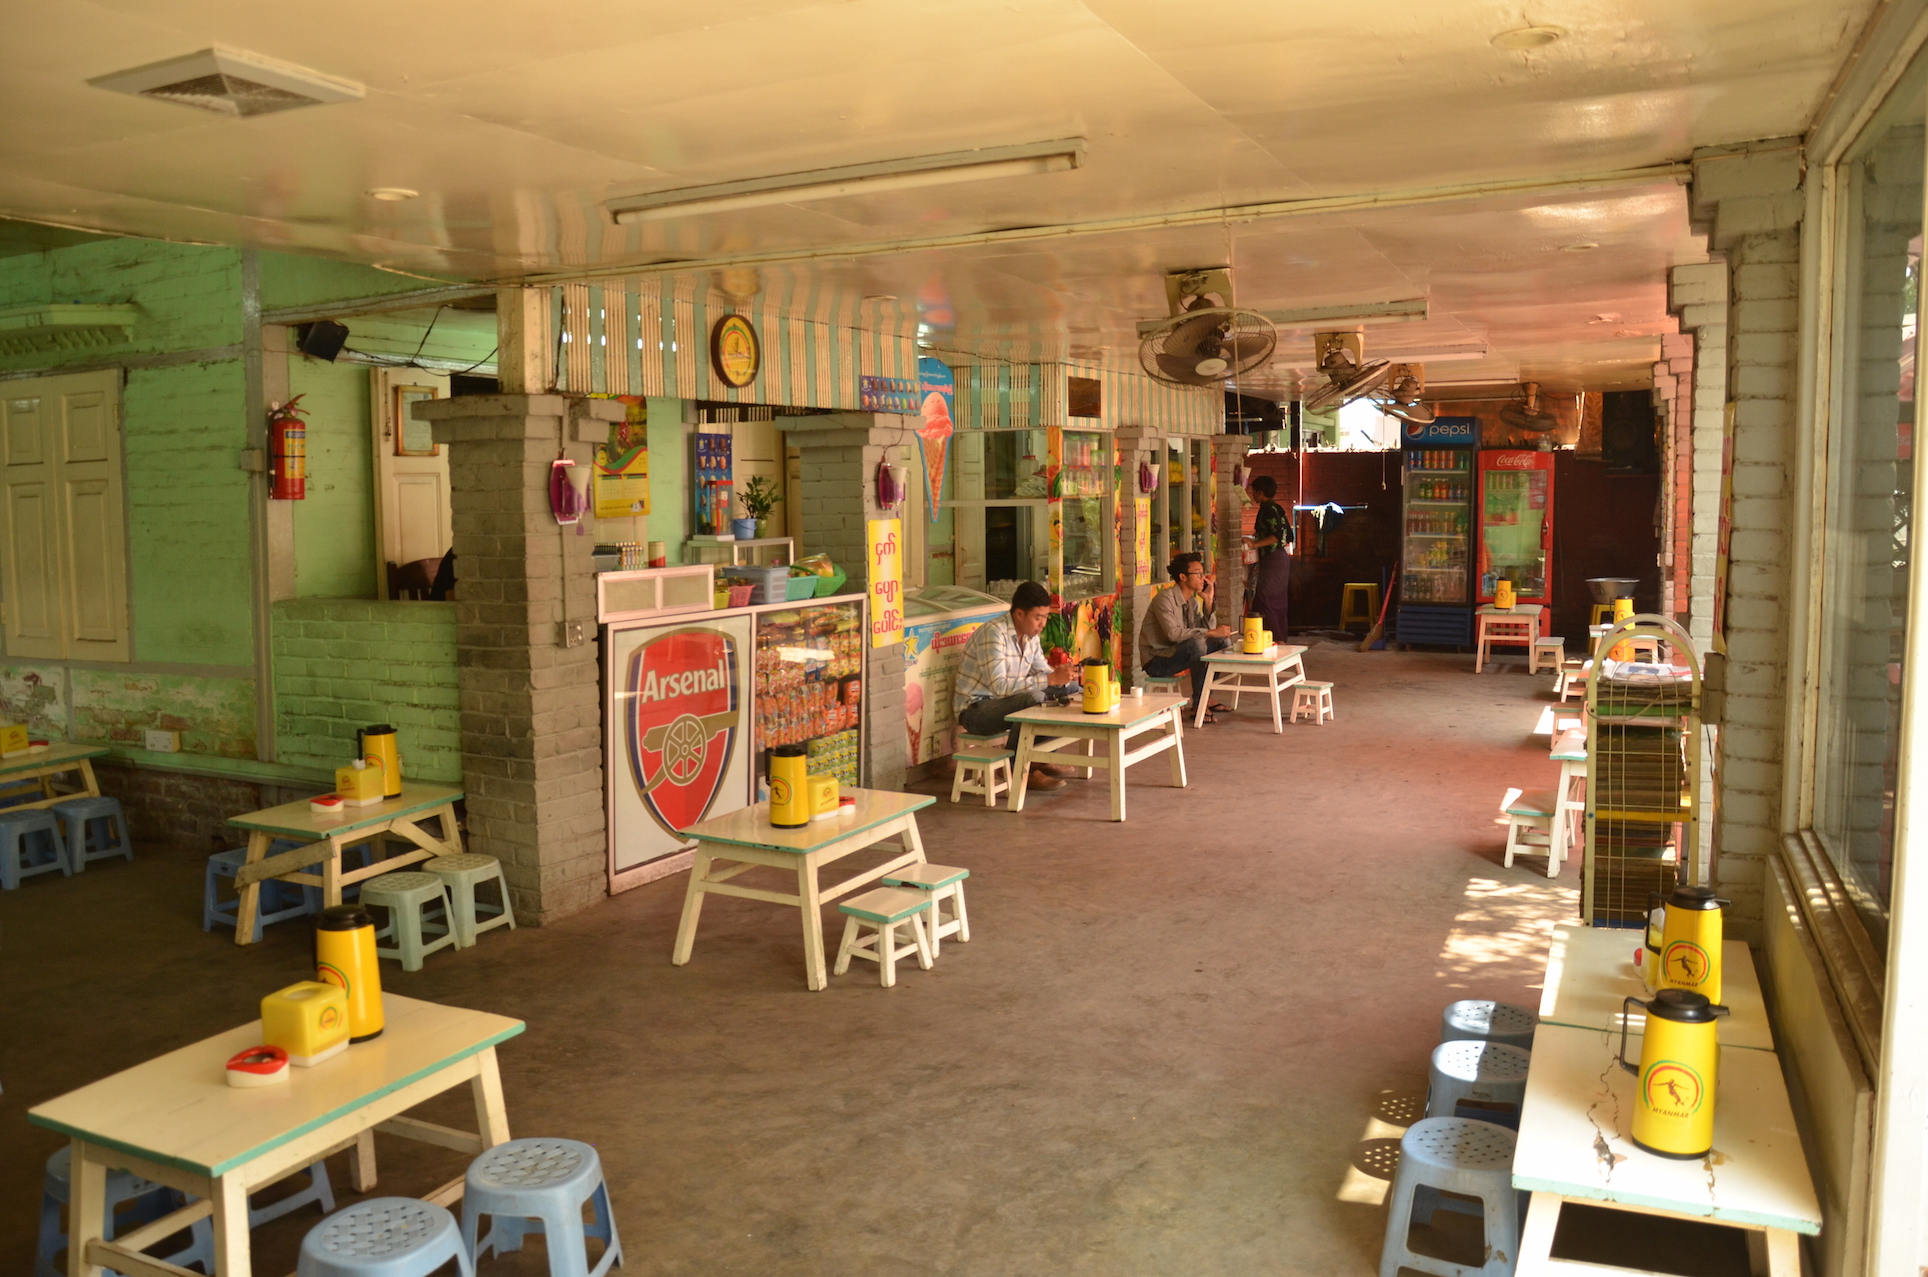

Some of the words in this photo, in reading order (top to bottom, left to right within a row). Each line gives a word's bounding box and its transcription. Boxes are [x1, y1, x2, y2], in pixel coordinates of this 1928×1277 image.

[1429, 423, 1469, 437] pepsi
[641, 658, 726, 704] Arsenal
[1652, 1107, 1689, 1118] MYANMAR
